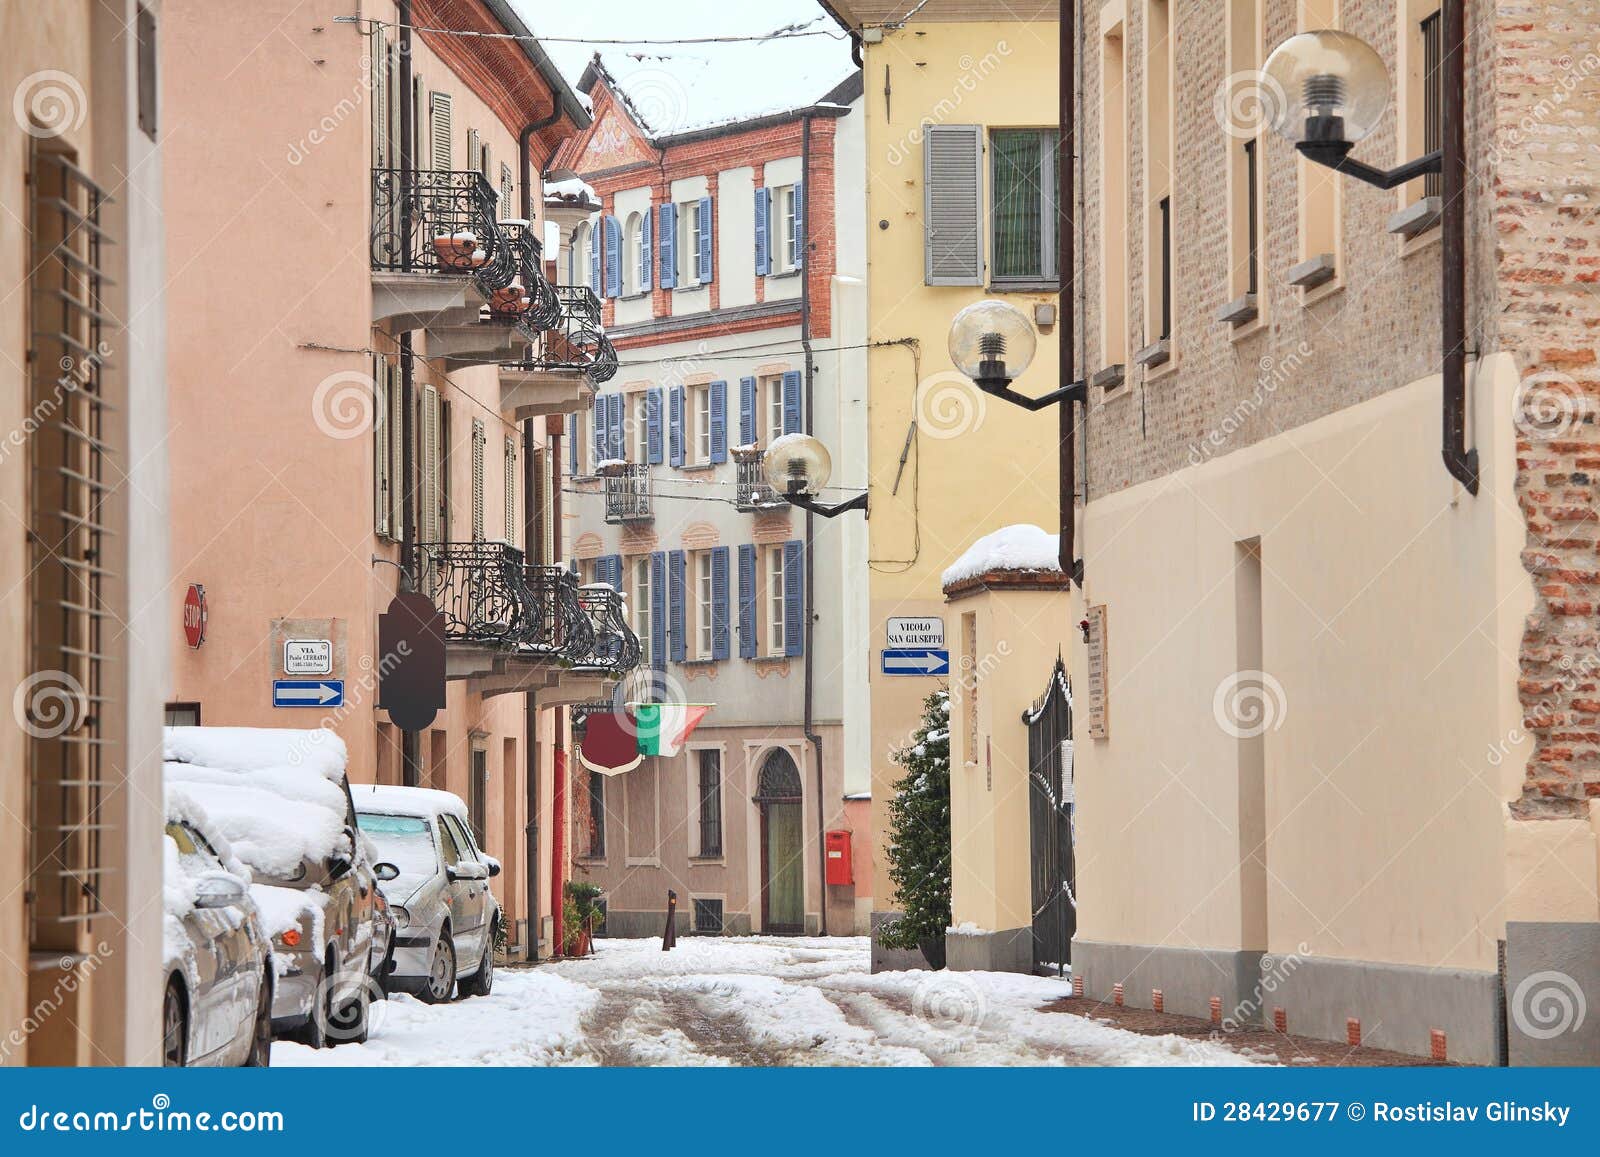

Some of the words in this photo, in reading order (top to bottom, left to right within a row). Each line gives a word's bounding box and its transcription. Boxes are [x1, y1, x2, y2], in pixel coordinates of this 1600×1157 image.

[184, 603, 200, 628] STOP
[900, 623, 931, 631] VICOLO
[889, 634, 903, 643] SAN
[906, 634, 942, 643] GIUSEPPE
